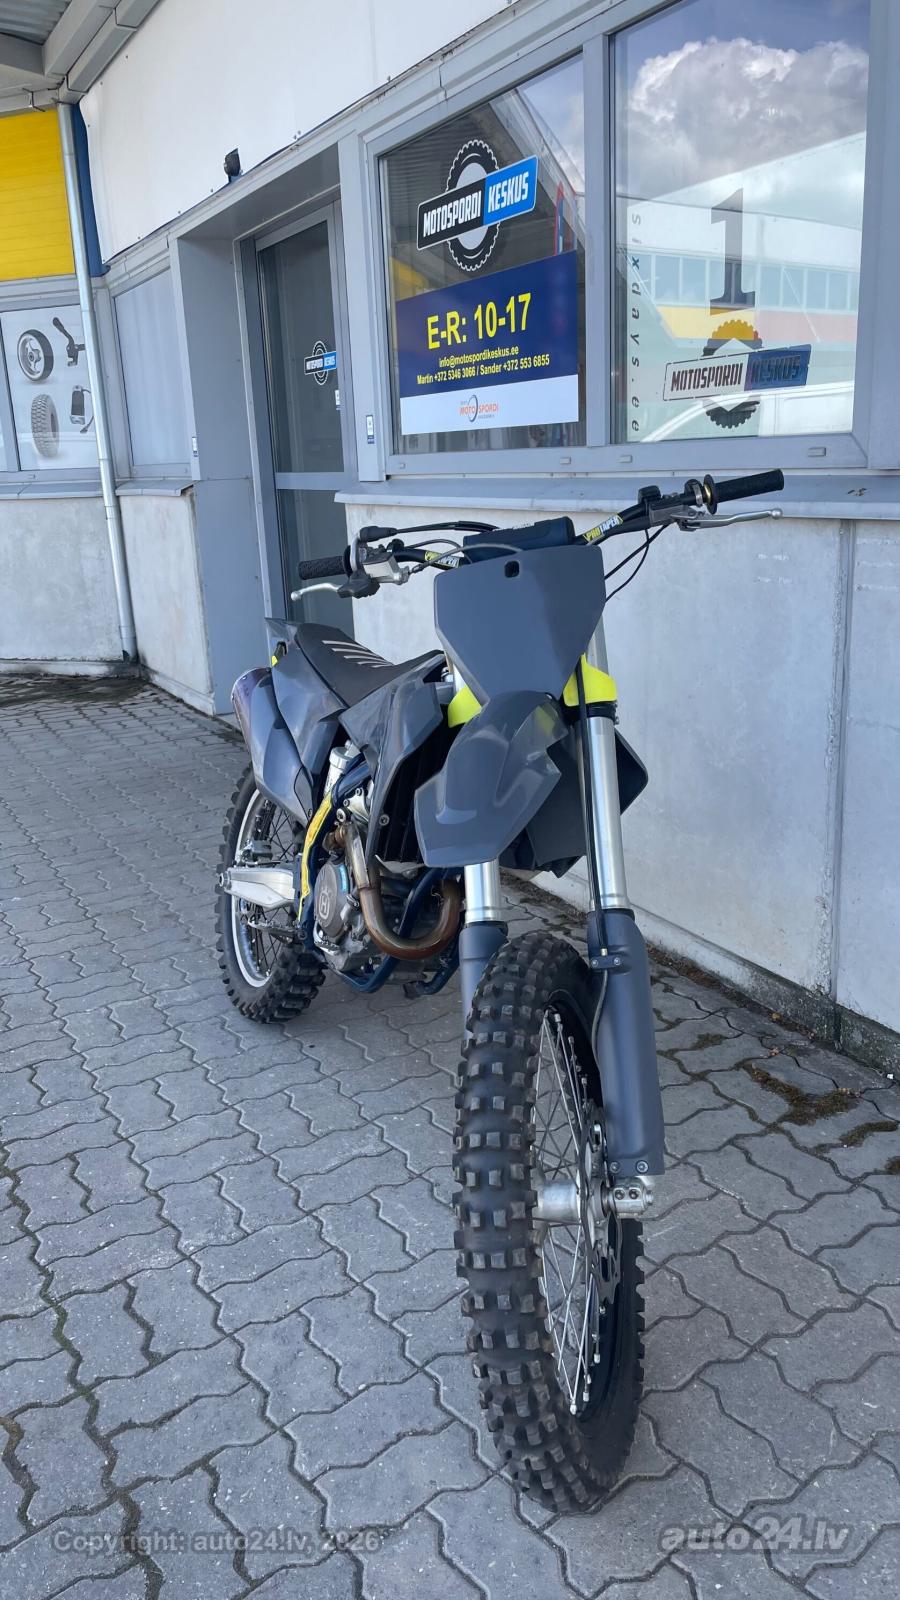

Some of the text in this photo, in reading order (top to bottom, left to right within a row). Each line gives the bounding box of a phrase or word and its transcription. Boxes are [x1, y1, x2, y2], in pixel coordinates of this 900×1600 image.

[423, 171, 529, 238] MOTOSPORDI KESKUS
[427, 292, 531, 350] E-R: 10-17
[417, 374, 434, 385] Martin
[434, 370, 447, 382] +372
[480, 362, 502, 375] Sander
[503, 359, 518, 371] +372
[520, 356, 532, 369] 553
[533, 353, 550, 367] 6855
[439, 345, 519, 368] info@motospordikeskus.ee
[670, 362, 744, 393] MOTOSPORDI
